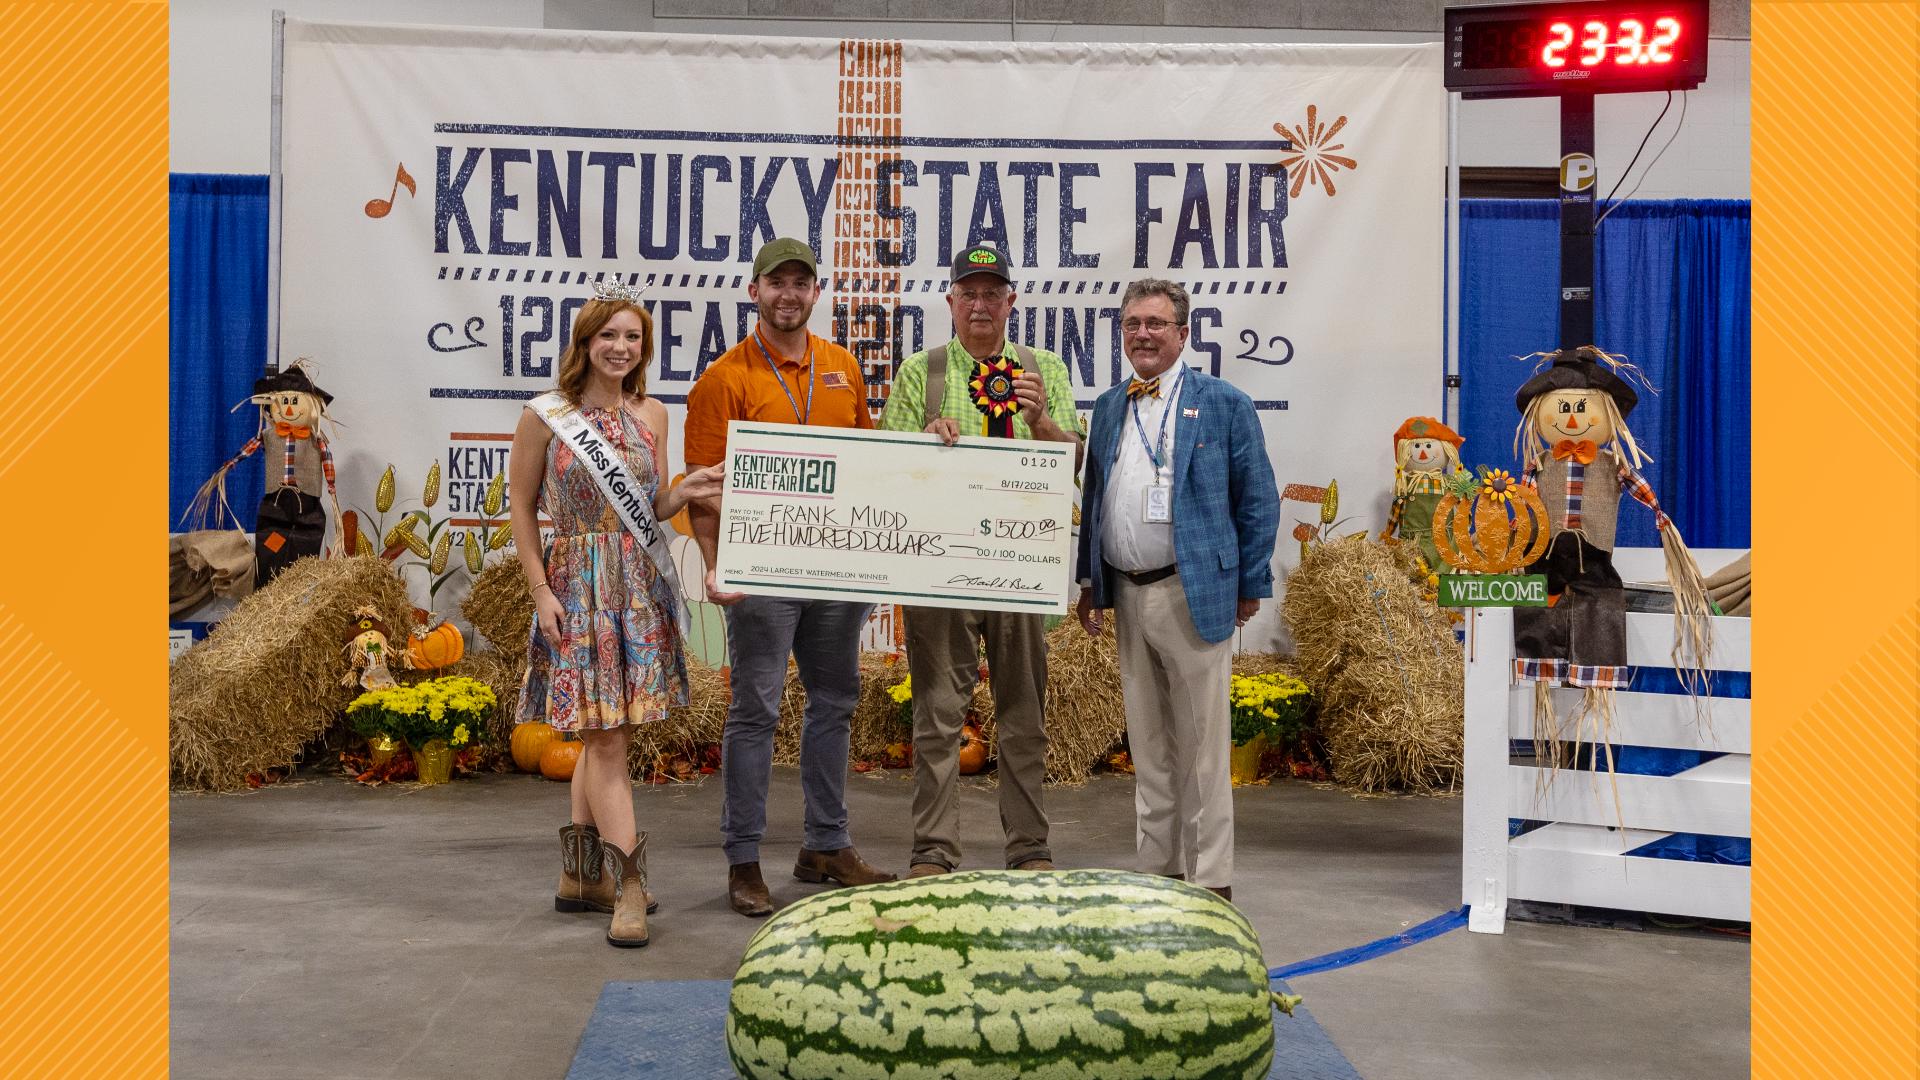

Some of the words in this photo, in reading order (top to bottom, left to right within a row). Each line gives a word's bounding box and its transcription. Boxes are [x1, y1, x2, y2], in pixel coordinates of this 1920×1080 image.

[1542, 17, 1680, 66] 233.2
[434, 146, 842, 264] KENTUCKY
[876, 158, 1101, 268] STATE
[1133, 162, 1289, 269] FAIR
[734, 454, 798, 474] KENTUCKY
[1021, 457, 1057, 468] 0120
[733, 472, 767, 489] STATE
[772, 475, 798, 491] FAIR
[798, 458, 836, 494] 120
[1001, 480, 1049, 491] 8/17/2024
[573, 429, 610, 471] Miss
[603, 466, 658, 548] Kentucky
[769, 504, 839, 526] FRANK
[850, 505, 908, 531] MUDD
[1018, 554, 1061, 565] DOLLARS
[750, 565, 769, 574] 2024
[770, 567, 804, 576] LARGEST
[806, 569, 856, 580] WATERMELON
[858, 573, 889, 581] WINNER
[1449, 580, 1544, 601] WELCOME
